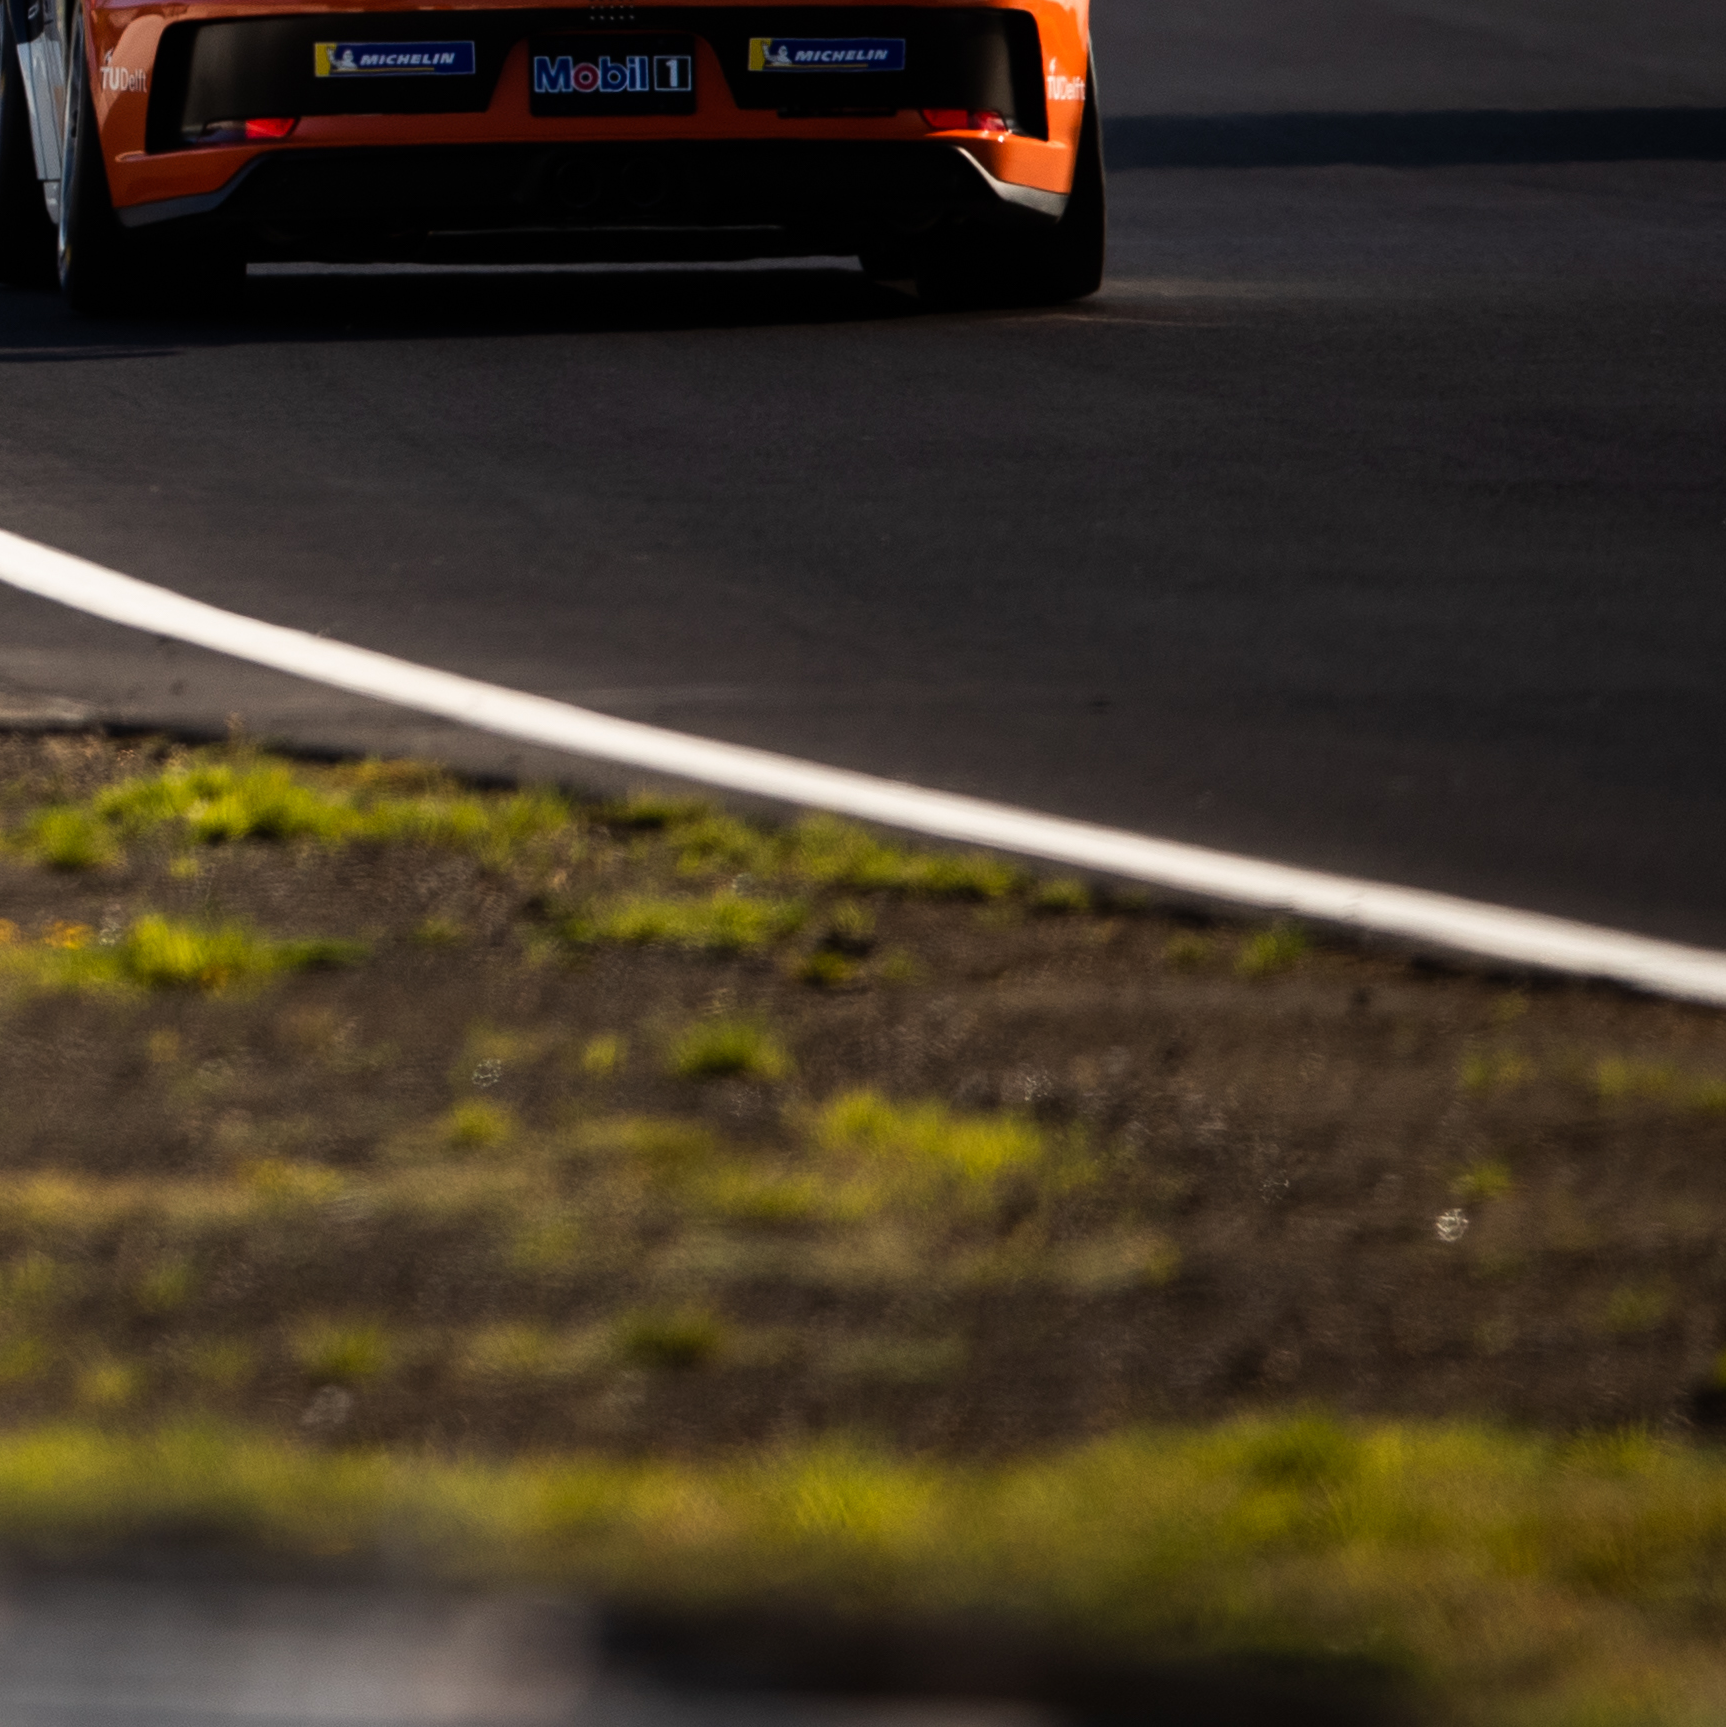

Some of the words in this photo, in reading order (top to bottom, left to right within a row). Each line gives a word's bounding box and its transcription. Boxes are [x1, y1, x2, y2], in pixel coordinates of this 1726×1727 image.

[359, 51, 456, 66] MICHELIN
[794, 49, 890, 63] MICHELIN
[533, 55, 650, 93] Mobil
